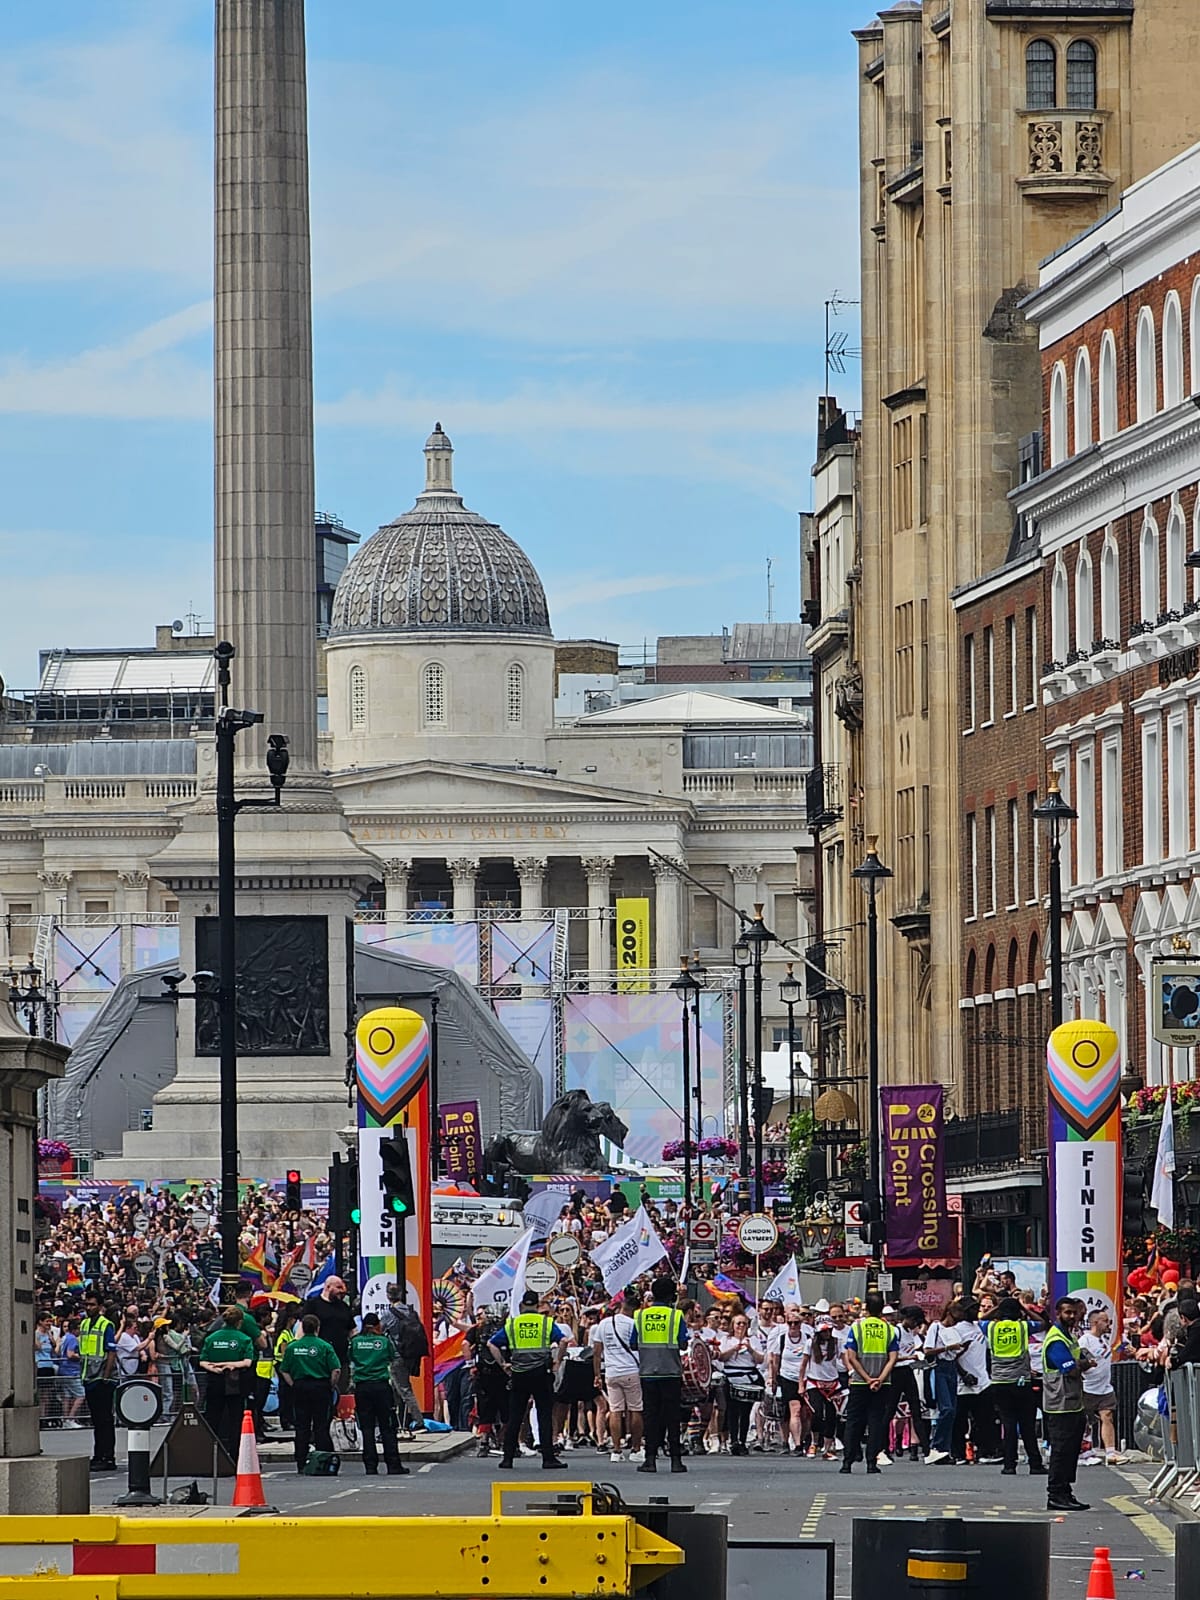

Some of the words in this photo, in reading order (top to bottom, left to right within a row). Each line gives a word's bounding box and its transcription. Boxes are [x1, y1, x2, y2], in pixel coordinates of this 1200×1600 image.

[352, 826, 454, 841] ATIONAL
[471, 825, 569, 841] GALLERY
[919, 1108, 933, 1119] 24
[464, 1135, 477, 1174] Cross
[890, 1145, 913, 1207] Point
[917, 1144, 942, 1250] Crossing
[1080, 1150, 1095, 1263] FINISH
[368, 1282, 381, 1297] WE
[907, 1282, 928, 1291] THIS
[519, 1329, 539, 1339] GL52
[645, 1323, 666, 1331] CA09
